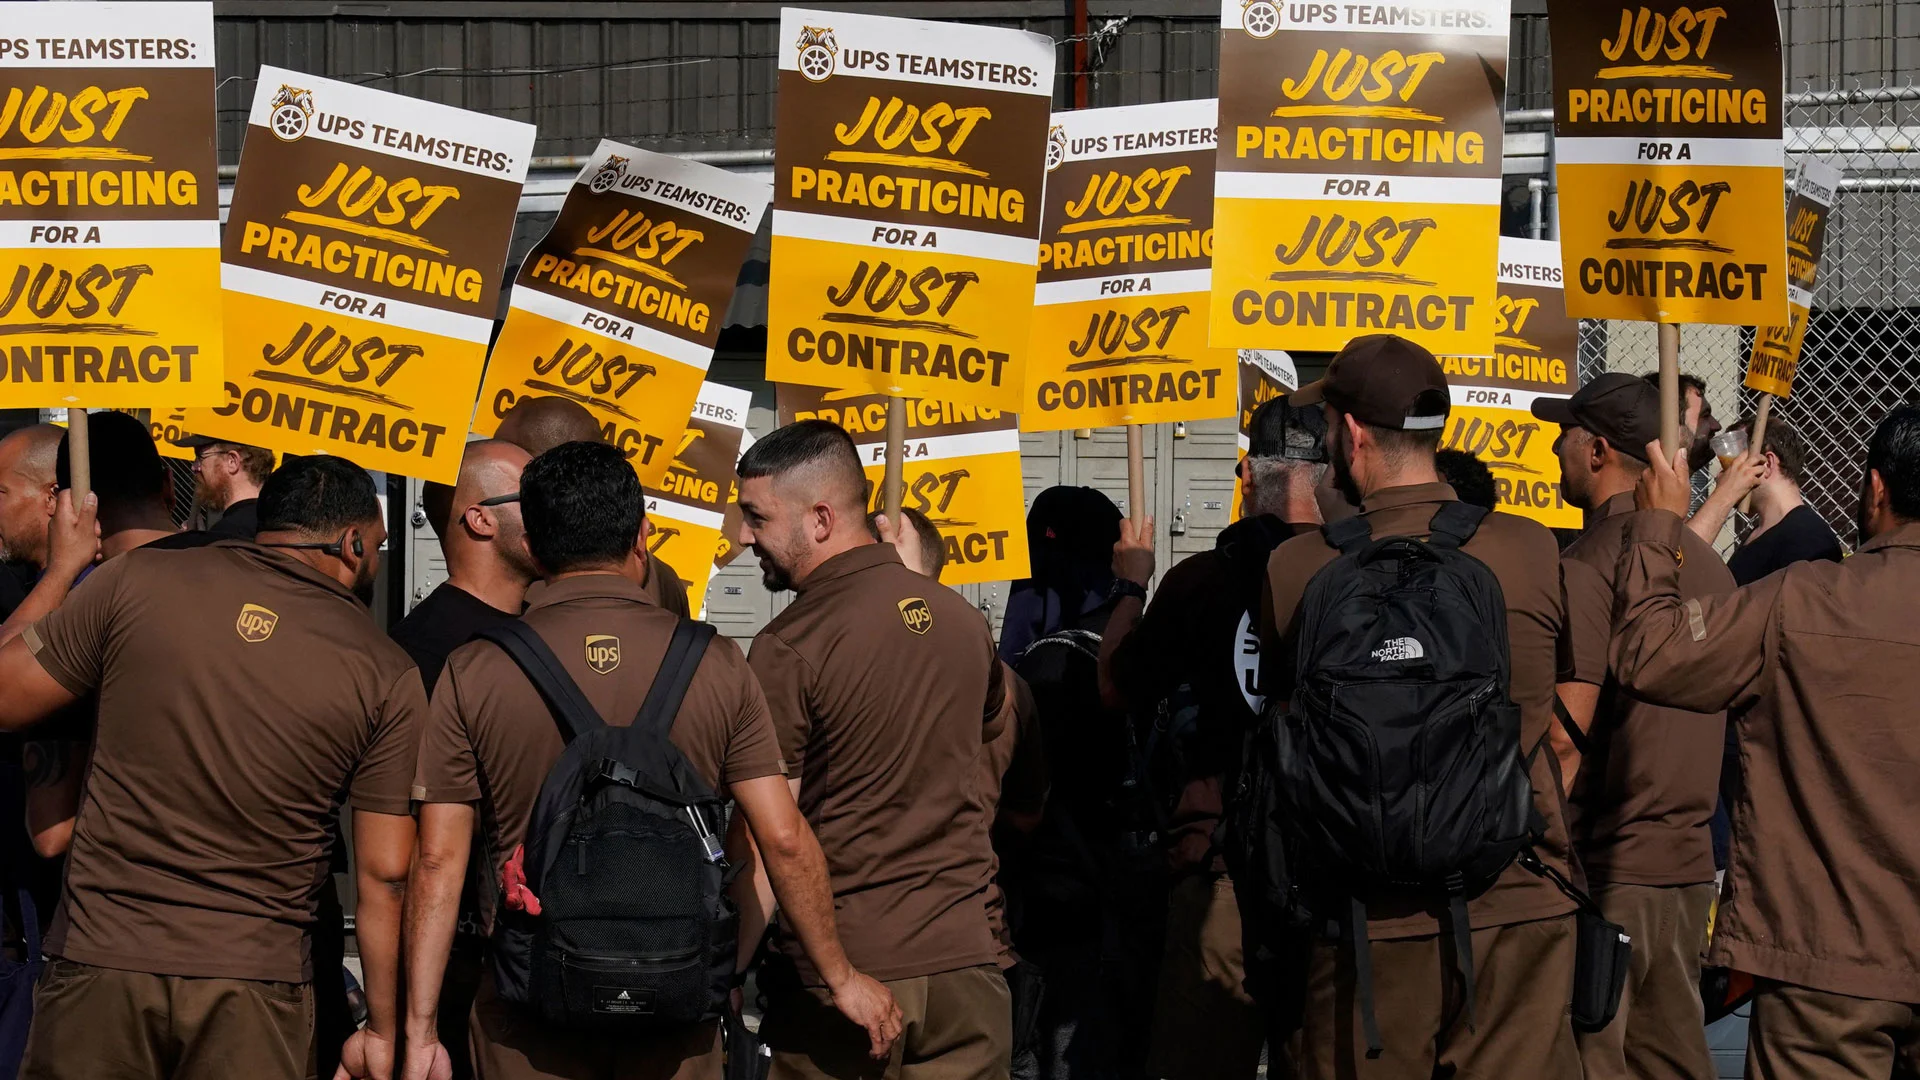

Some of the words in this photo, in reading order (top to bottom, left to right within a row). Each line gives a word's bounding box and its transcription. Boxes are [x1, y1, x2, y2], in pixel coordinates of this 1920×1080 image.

[1290, 3, 1338, 24] UPS
[36, 38, 196, 60] TEAMSTERS:
[1601, 6, 1728, 63] JUST
[843, 48, 890, 72] UPS
[896, 53, 1038, 88] TEAMSTERS:
[1281, 48, 1446, 104] JUST
[835, 96, 991, 155] JUST
[1568, 88, 1767, 124] PRACTICING
[317, 112, 366, 140] UPS
[372, 123, 514, 174] TEAMSTERS:
[1071, 136, 1108, 155] UPS
[1236, 126, 1484, 165] PRACTICING
[1638, 143, 1672, 160] FOR
[1676, 143, 1692, 160] A
[297, 162, 460, 230] JUST
[620, 174, 653, 193] UPS
[653, 181, 751, 224] TEAMSTERS:
[791, 167, 1024, 223] PRACTICING
[1065, 165, 1192, 219] JUST
[1323, 179, 1370, 196] FOR
[1373, 180, 1391, 197] A
[1607, 178, 1732, 235] JUST
[30, 226, 78, 243] FOR
[84, 226, 101, 243] A
[587, 208, 704, 265] JUST
[872, 227, 917, 248] FOR
[921, 231, 937, 248] A
[1274, 212, 1438, 268] JUST
[1789, 207, 1819, 243] JUST
[240, 221, 482, 303] PRACTICING
[1037, 228, 1214, 272] PRACTICING
[827, 261, 980, 318] JUST
[1100, 280, 1134, 295] FOR
[1138, 278, 1152, 293] A
[1498, 262, 1562, 282] MSTERS
[1579, 257, 1768, 300] CONTRACT
[320, 290, 367, 314] FOR
[369, 302, 387, 319] A
[531, 253, 709, 334] PRACTICING
[1231, 289, 1475, 332] CONTRACT
[581, 312, 617, 338] FOR
[619, 323, 634, 341] A
[1069, 305, 1190, 358] JUST
[0, 345, 199, 383] NTRACT
[262, 322, 424, 387] JUST
[533, 338, 656, 400] JUST
[787, 327, 1010, 387] CONTRACT
[1037, 368, 1221, 412] CONTRACT
[1466, 391, 1498, 404] FOR
[1501, 392, 1512, 406] A
[212, 382, 446, 457] CONTRACT
[1438, 416, 1540, 459] JUST
[872, 444, 911, 461] FR
[915, 442, 929, 457] A
[241, 612, 272, 635] ups
[903, 607, 930, 629] ups
[588, 646, 618, 668] ups
[1371, 645, 1405, 658] NORTH
[1380, 652, 1405, 662] FACE
[1383, 637, 1405, 648] THE
